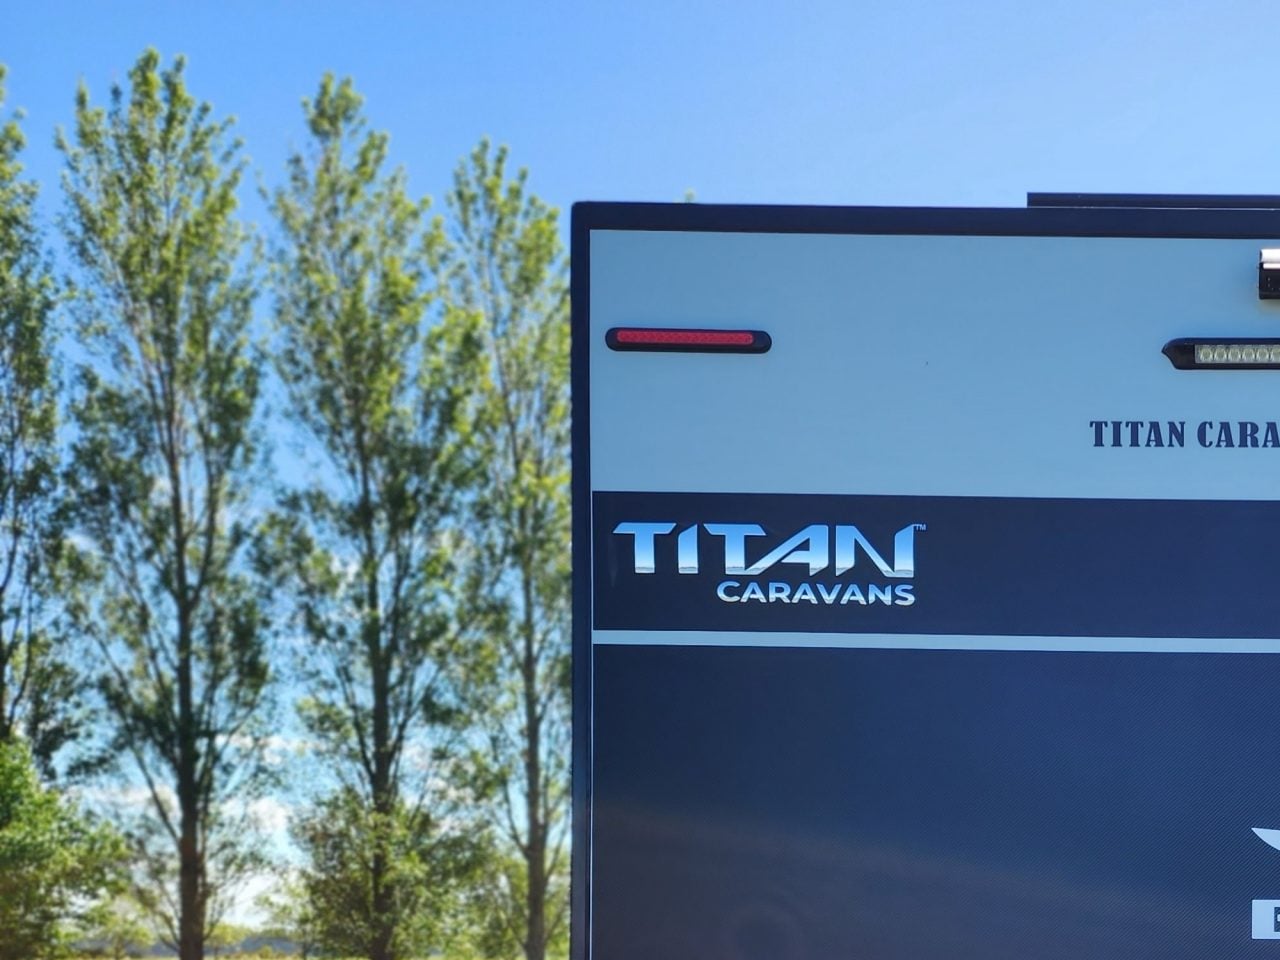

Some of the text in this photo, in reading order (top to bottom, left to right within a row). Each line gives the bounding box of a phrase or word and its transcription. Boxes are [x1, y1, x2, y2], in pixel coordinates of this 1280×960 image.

[1089, 420, 1187, 449] TITAN
[611, 521, 916, 579] TITAN
[716, 580, 917, 606] CARAVANS
